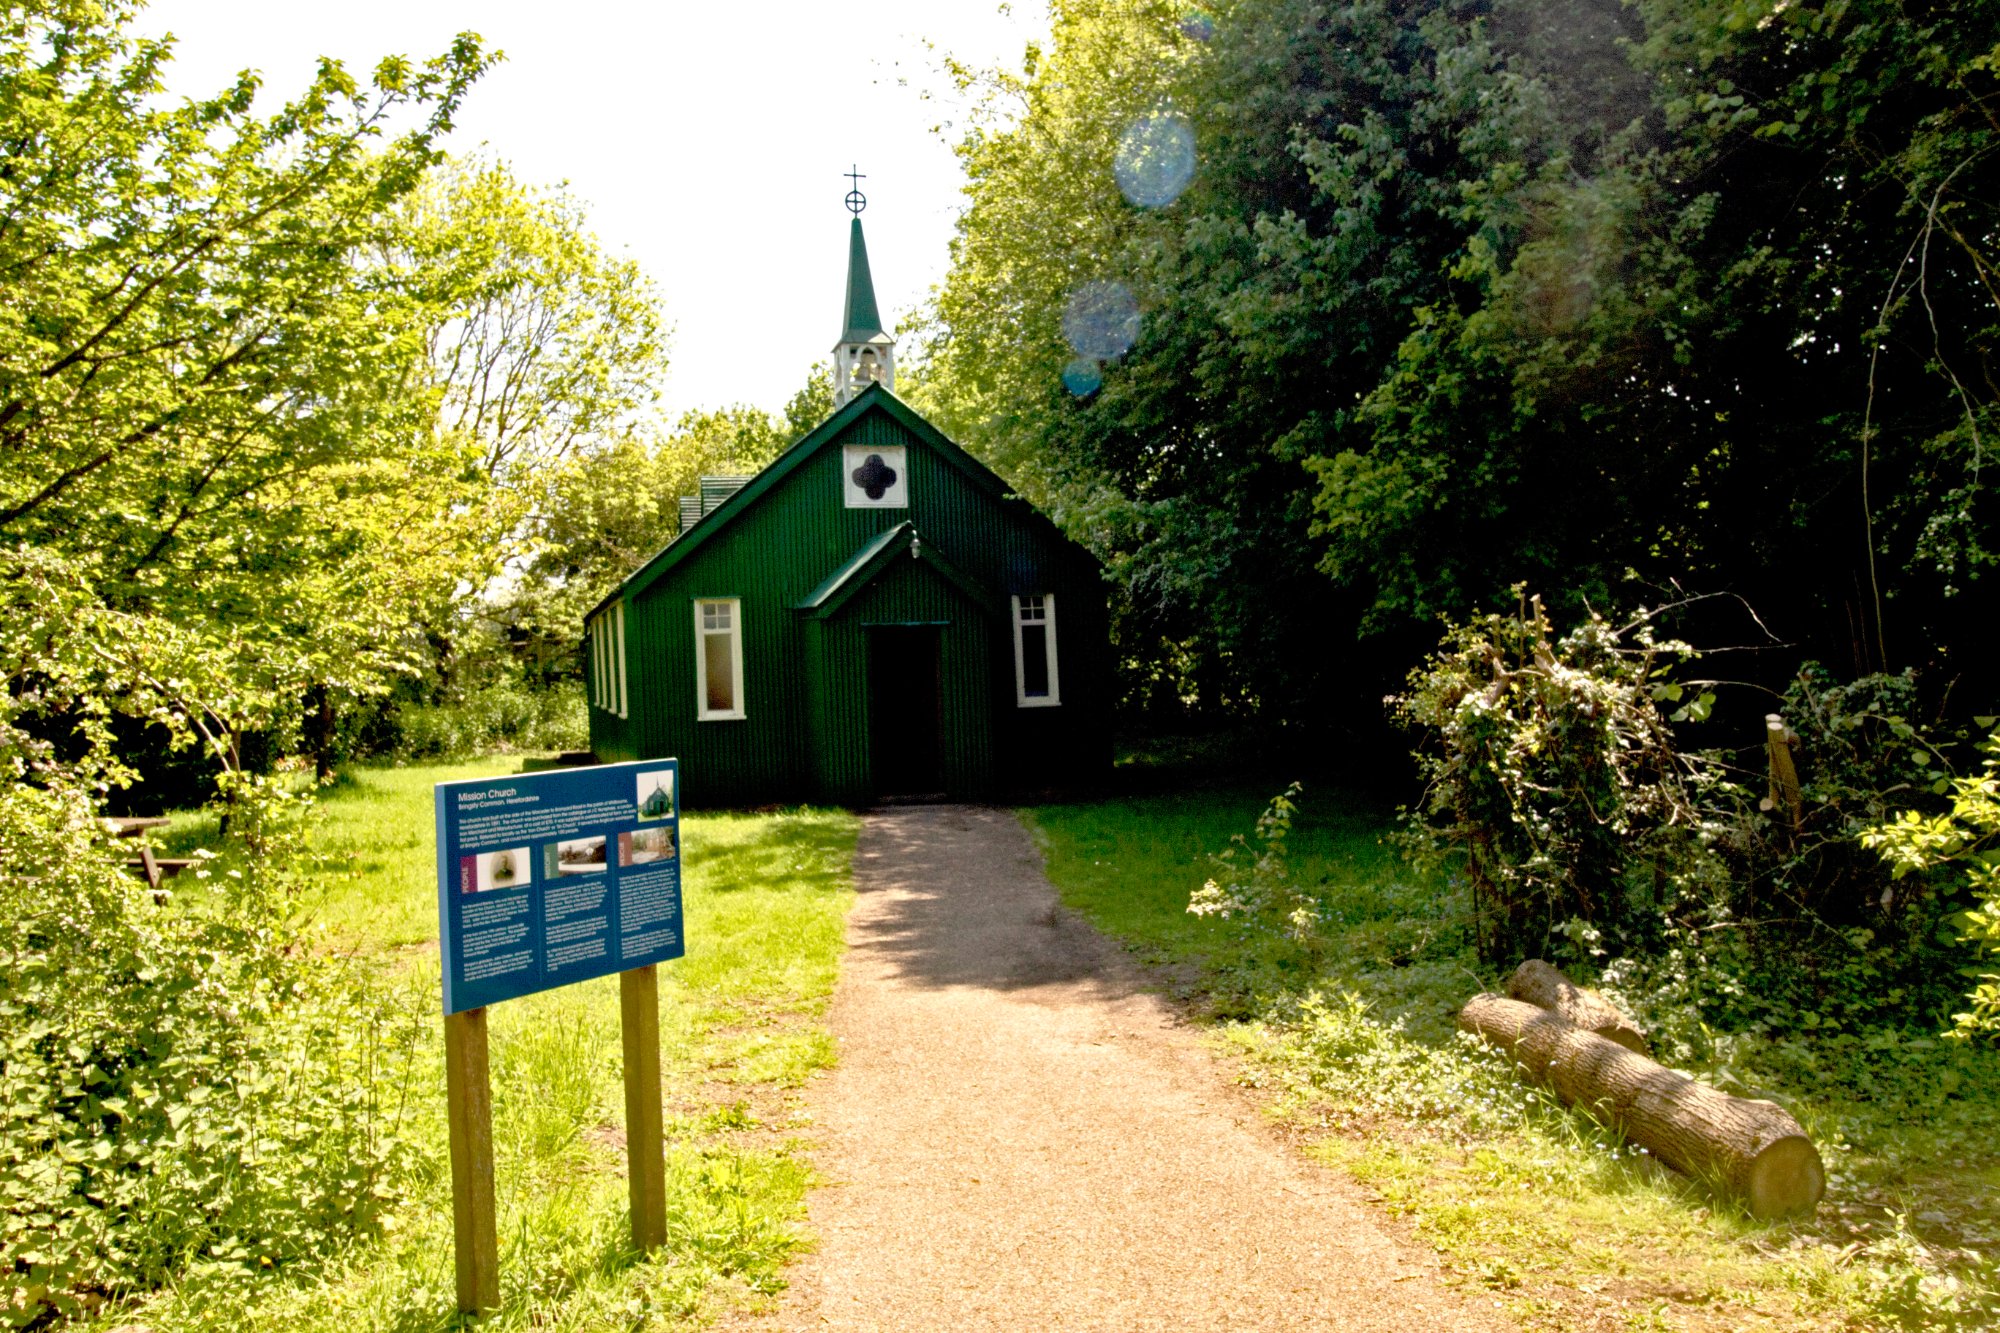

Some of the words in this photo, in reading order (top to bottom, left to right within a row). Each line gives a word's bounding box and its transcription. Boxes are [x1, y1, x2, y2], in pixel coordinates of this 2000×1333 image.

[458, 792, 486, 802] Mission
[488, 788, 517, 798] Church
[461, 866, 469, 893] PEOPLE
